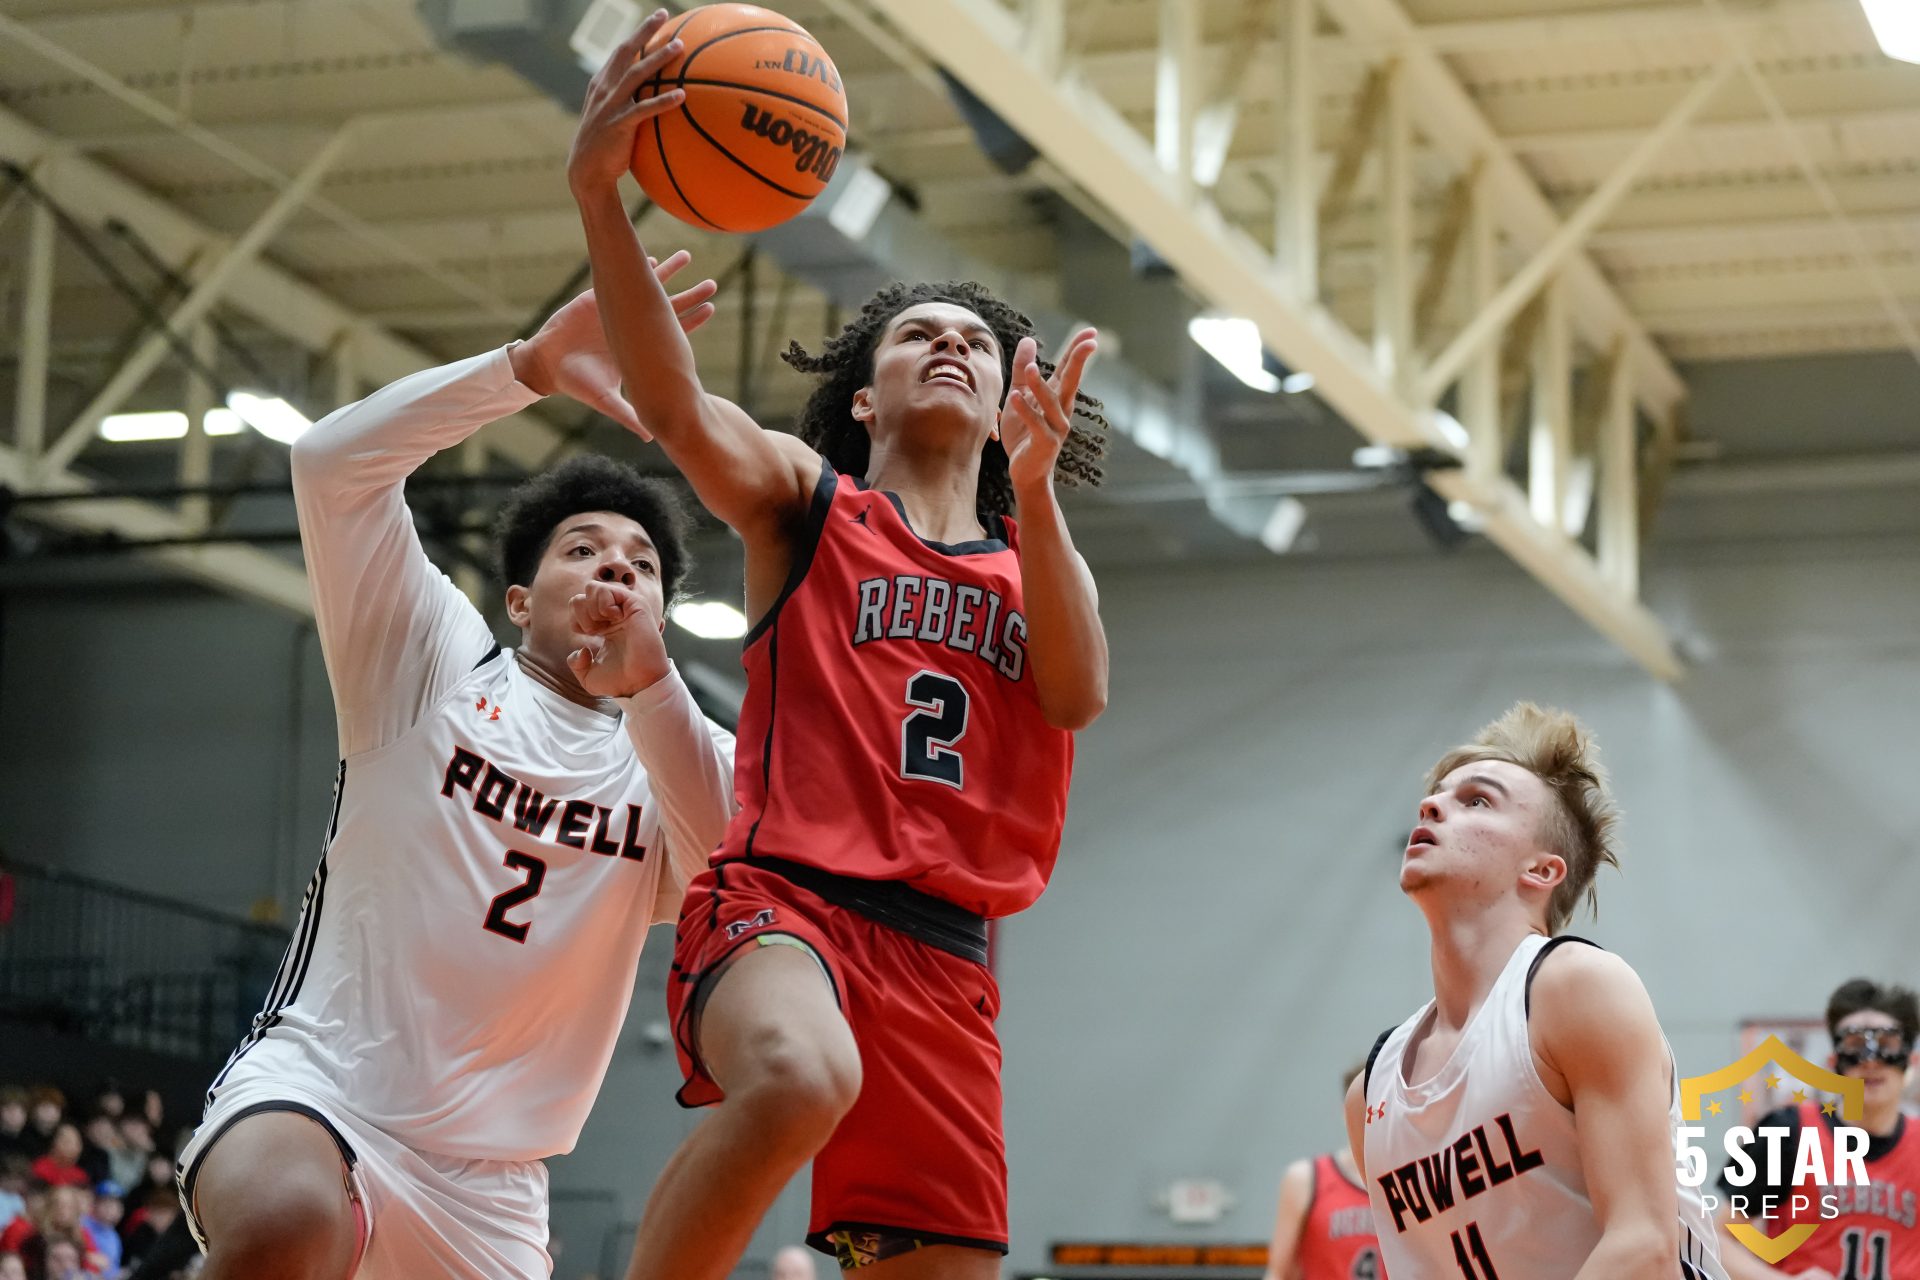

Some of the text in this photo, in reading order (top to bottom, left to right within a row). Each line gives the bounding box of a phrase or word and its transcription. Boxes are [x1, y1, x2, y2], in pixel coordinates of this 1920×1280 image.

[852, 574, 1028, 682] REBELS
[900, 669, 970, 791] 2
[440, 744, 647, 862] POWELL
[482, 849, 548, 944] 2
[1377, 1112, 1545, 1233] POWELL
[1449, 1221, 1500, 1280] 11
[1839, 1226, 1892, 1280] 11
